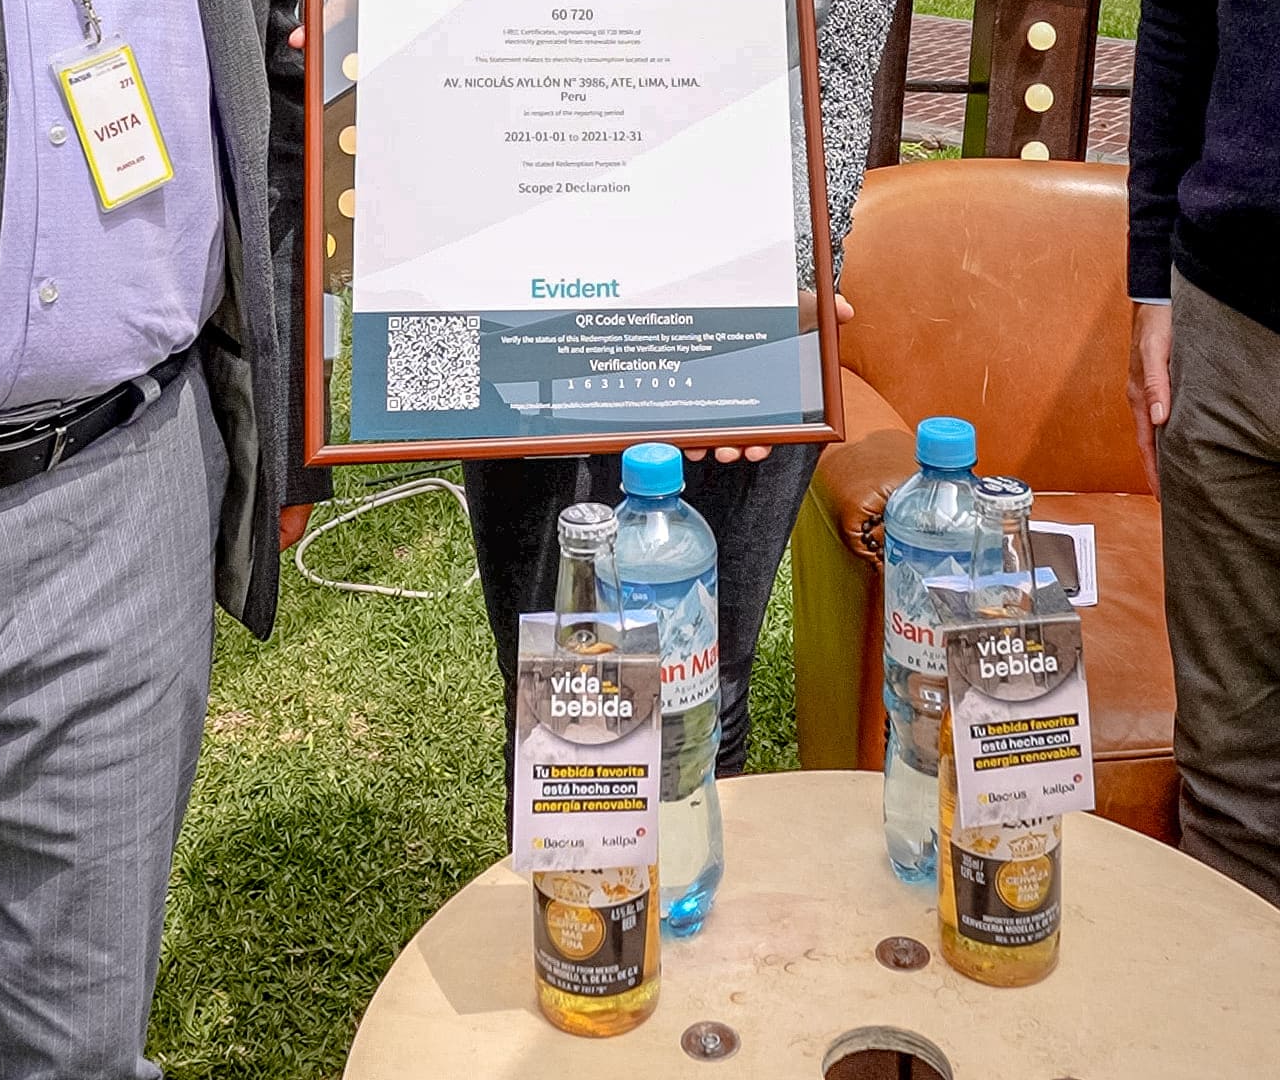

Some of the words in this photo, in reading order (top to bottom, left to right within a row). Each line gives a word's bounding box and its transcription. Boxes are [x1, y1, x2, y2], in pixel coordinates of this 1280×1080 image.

[551, 9, 568, 21] 60
[570, 9, 594, 21] 720
[119, 76, 135, 89] 271
[443, 77, 462, 88] AV.
[464, 76, 514, 88] NICOLÁS
[516, 75, 559, 88] AYLLÓN
[579, 77, 609, 90] 3986,
[611, 77, 636, 90] ATE,
[638, 78, 669, 90] LIMA,
[671, 78, 701, 88] LIMA.
[560, 91, 587, 102] Peru
[94, 113, 142, 142] VISITA
[504, 131, 566, 142] 2021-01-01
[569, 133, 579, 142] to
[581, 131, 642, 142] 2021-12-31
[518, 182, 554, 195] Scope
[555, 183, 562, 193] 2
[565, 182, 631, 193] Declaration
[531, 278, 620, 299] Evident
[575, 314, 593, 327] QR
[595, 313, 626, 326] Code
[627, 312, 693, 326] Verification
[500, 335, 521, 345] Verify
[522, 335, 534, 343] the
[535, 335, 557, 343] status
[558, 334, 566, 343] of
[566, 334, 580, 343] this
[580, 334, 623, 344] Redemption
[623, 334, 660, 342] Statement
[661, 333, 670, 343] by
[671, 333, 702, 342] scanning
[703, 333, 715, 341] the
[715, 332, 726, 341] QR
[727, 332, 744, 341] code
[755, 332, 767, 340] the
[558, 345, 570, 354] left
[570, 345, 585, 354] and
[585, 345, 615, 355] entering
[615, 345, 623, 353] in
[623, 344, 636, 353] the
[636, 344, 676, 353] Verification
[676, 344, 690, 354] Key
[690, 344, 713, 352] below
[589, 358, 657, 372] Verification
[659, 358, 681, 373] Key
[891, 611, 934, 647] San
[977, 636, 1024, 657] vida
[907, 656, 921, 667] DE
[980, 652, 1058, 679] bebida
[551, 671, 600, 694] vida
[551, 694, 633, 717] bebida
[972, 726, 987, 738] Tu
[987, 722, 1029, 735] bebida
[1030, 717, 1075, 730] favorita
[982, 741, 1008, 752] está
[1009, 735, 1046, 749] hecha
[1046, 733, 1069, 744] con
[975, 755, 1019, 769] energía
[1020, 747, 1080, 763] renovable.
[535, 766, 550, 778] Tu
[551, 766, 595, 778] bebida
[596, 766, 645, 777] favorita
[543, 784, 570, 795] está
[572, 783, 610, 795] hecha
[612, 784, 636, 794] con
[1042, 783, 1075, 796] kallpa
[534, 800, 581, 812] energía
[582, 799, 646, 811] renovable.
[602, 836, 637, 847] kallpa
